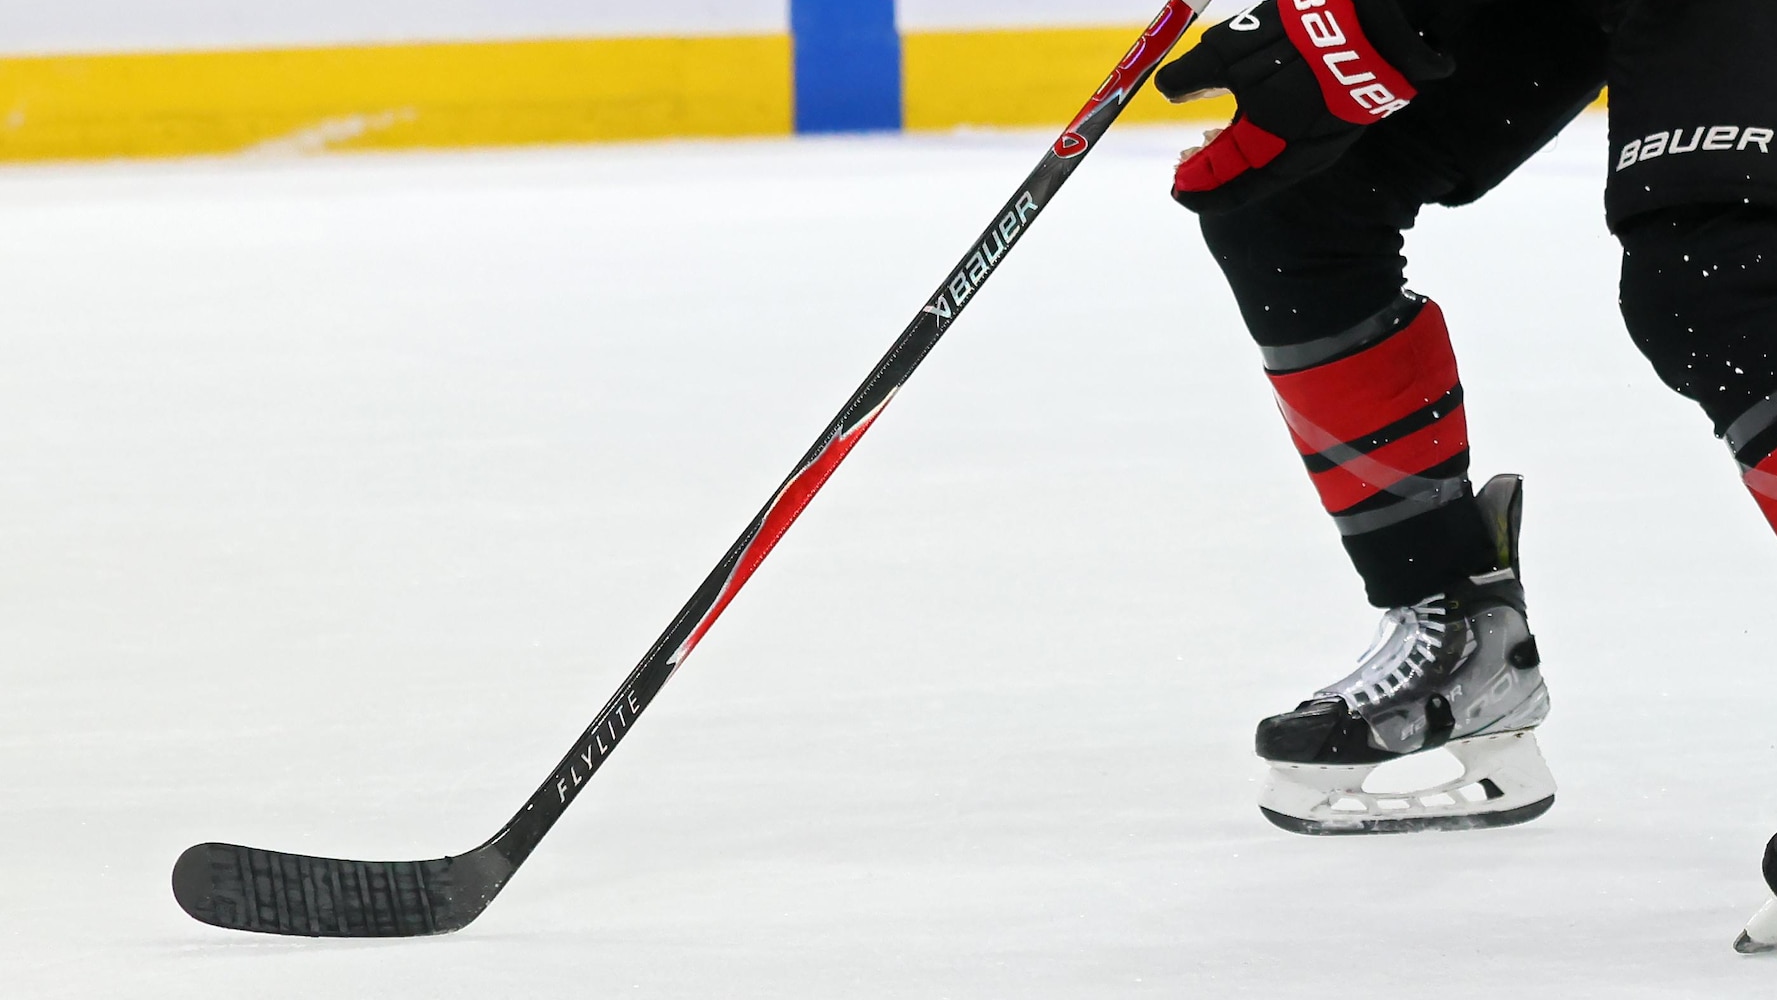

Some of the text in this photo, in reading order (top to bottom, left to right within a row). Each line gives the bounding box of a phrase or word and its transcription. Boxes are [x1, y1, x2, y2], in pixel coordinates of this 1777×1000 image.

[1616, 125, 1774, 172] BAUER
[950, 190, 1039, 308] BAUER
[556, 689, 640, 803] FLYLITE
